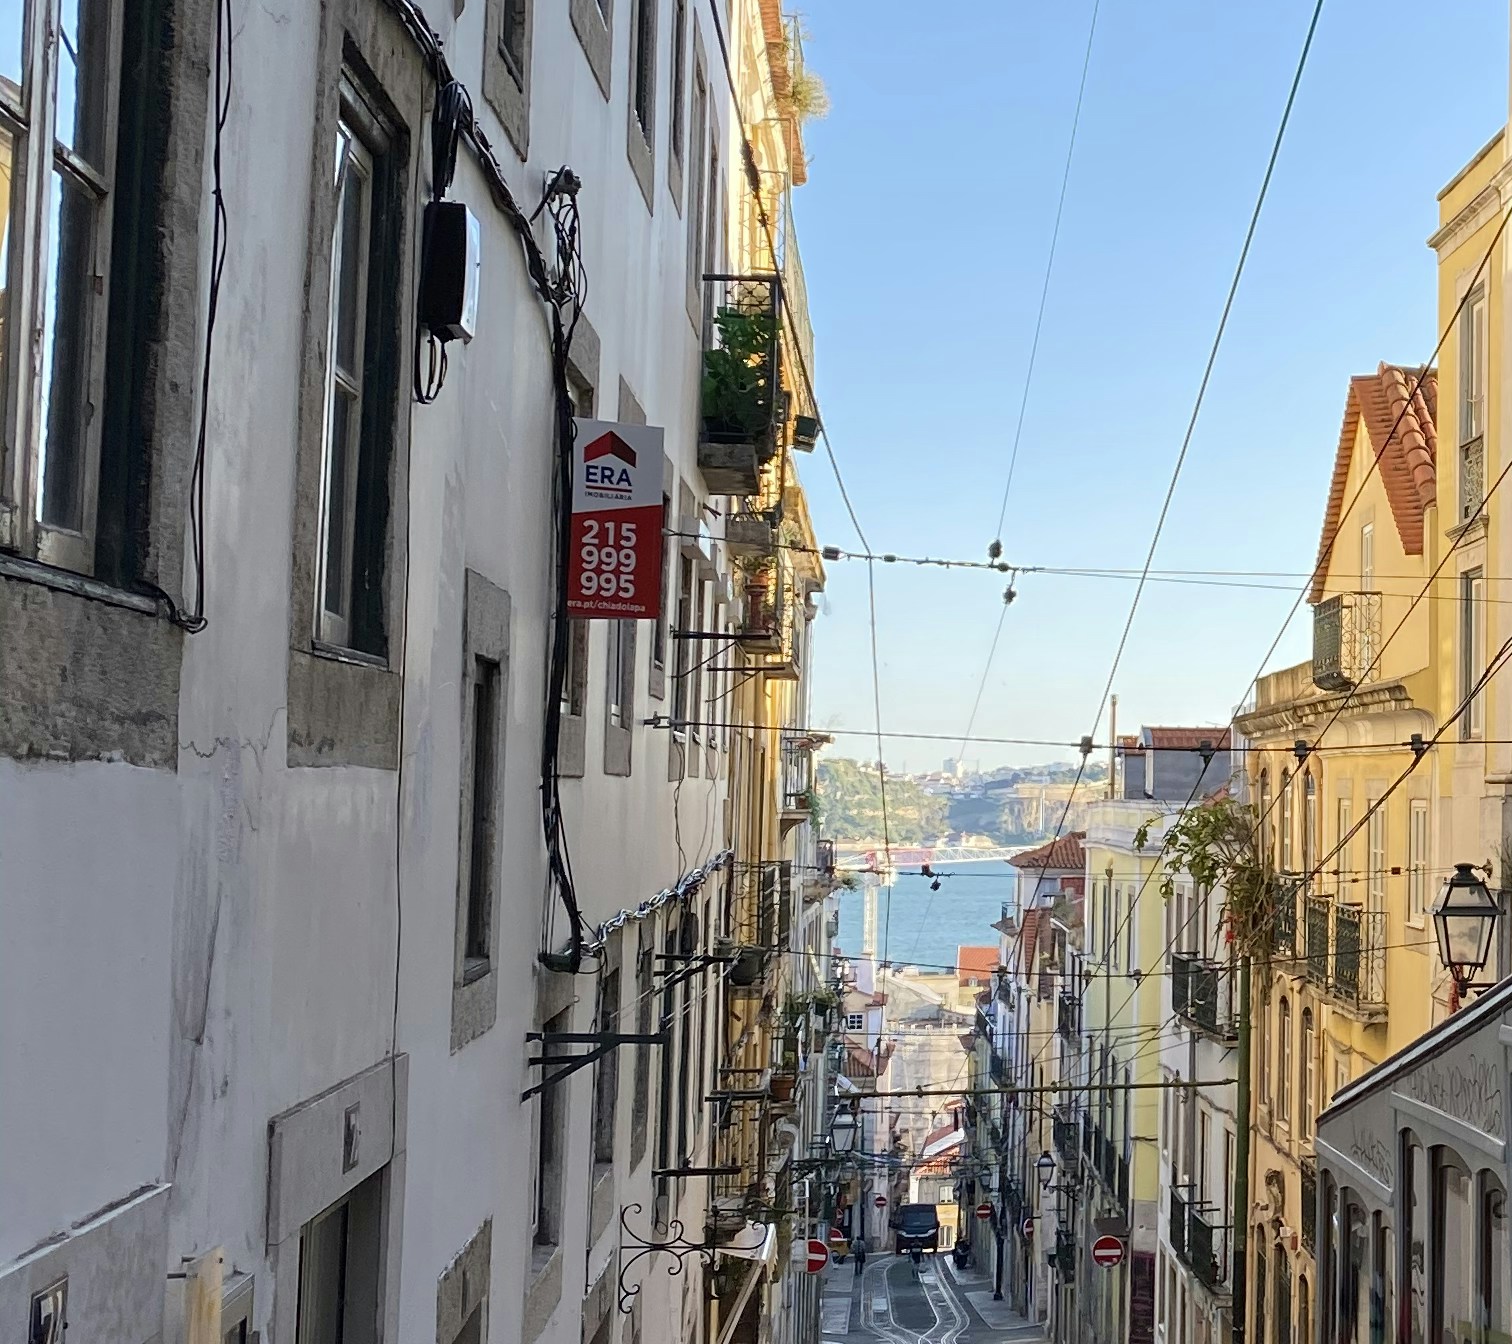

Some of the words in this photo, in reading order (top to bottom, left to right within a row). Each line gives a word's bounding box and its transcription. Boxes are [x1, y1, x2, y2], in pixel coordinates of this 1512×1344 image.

[585, 464, 633, 487] ERA
[581, 519, 637, 548] 215
[580, 545, 637, 573] 999
[580, 571, 636, 599] 995
